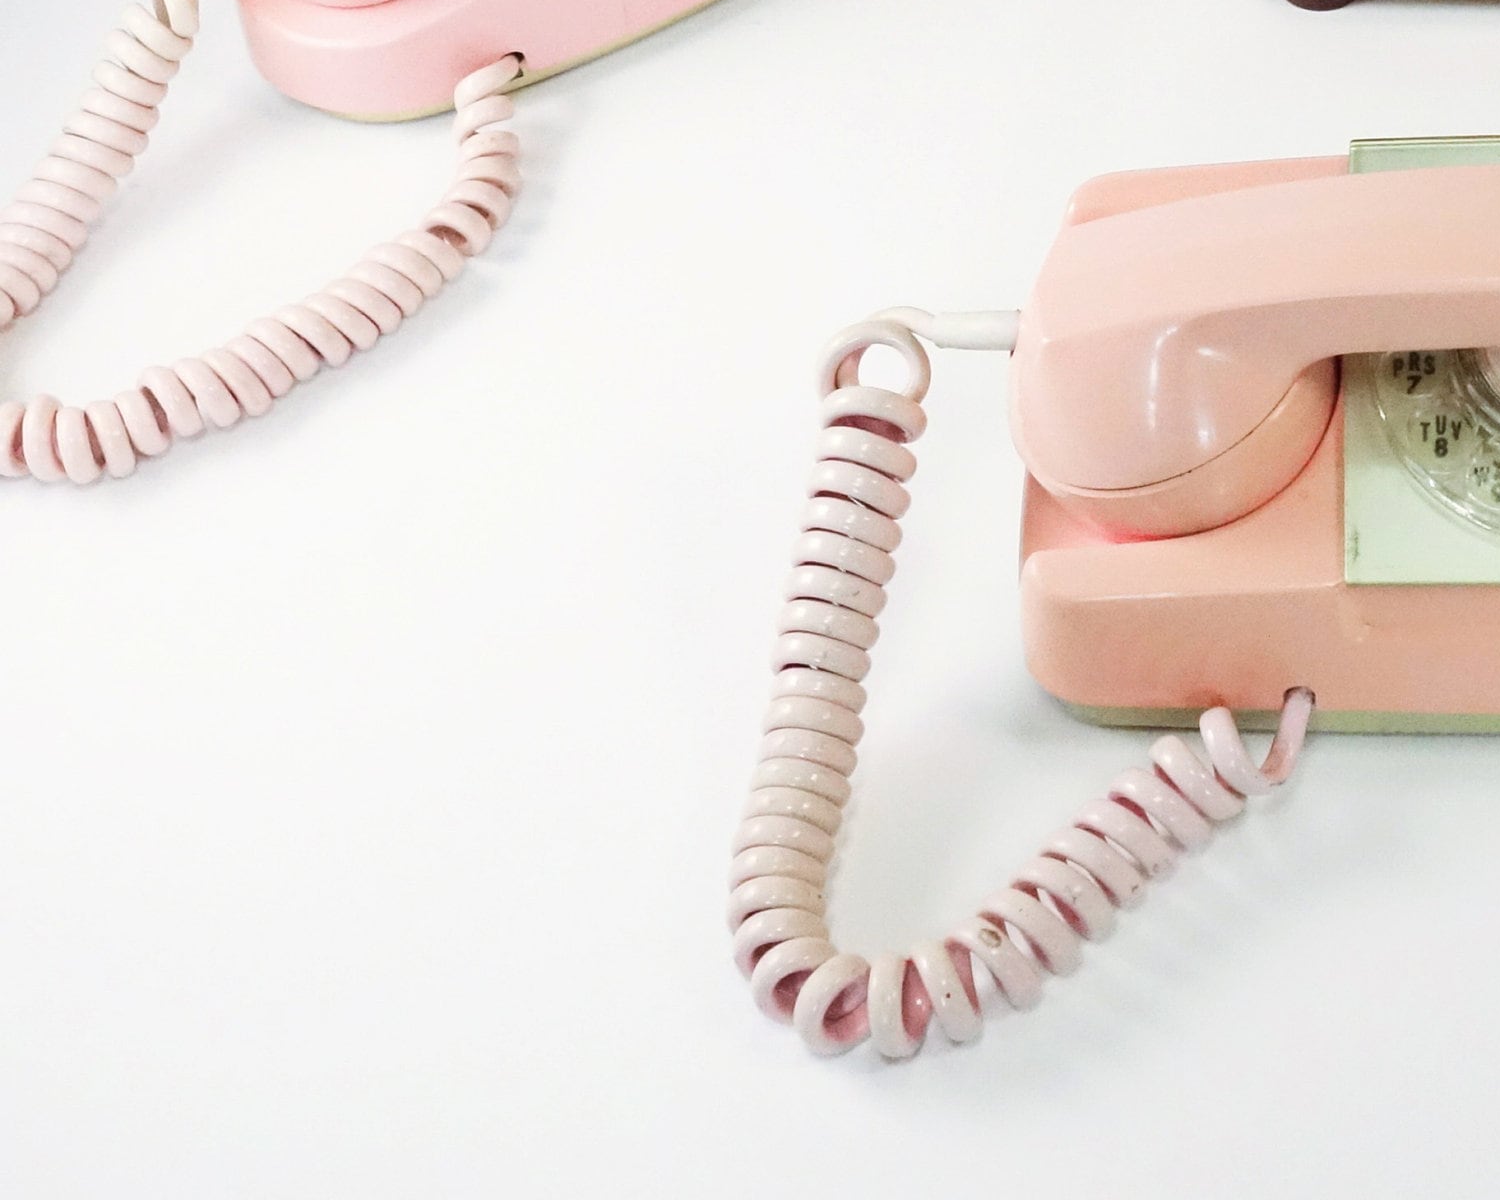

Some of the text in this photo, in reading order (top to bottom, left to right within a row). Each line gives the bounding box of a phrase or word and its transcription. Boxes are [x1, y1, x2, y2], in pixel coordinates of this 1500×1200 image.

[1392, 351, 1436, 379] PRS
[1407, 375, 1422, 395] 7
[1420, 414, 1462, 442] TUV
[1434, 437, 1449, 458] 8
